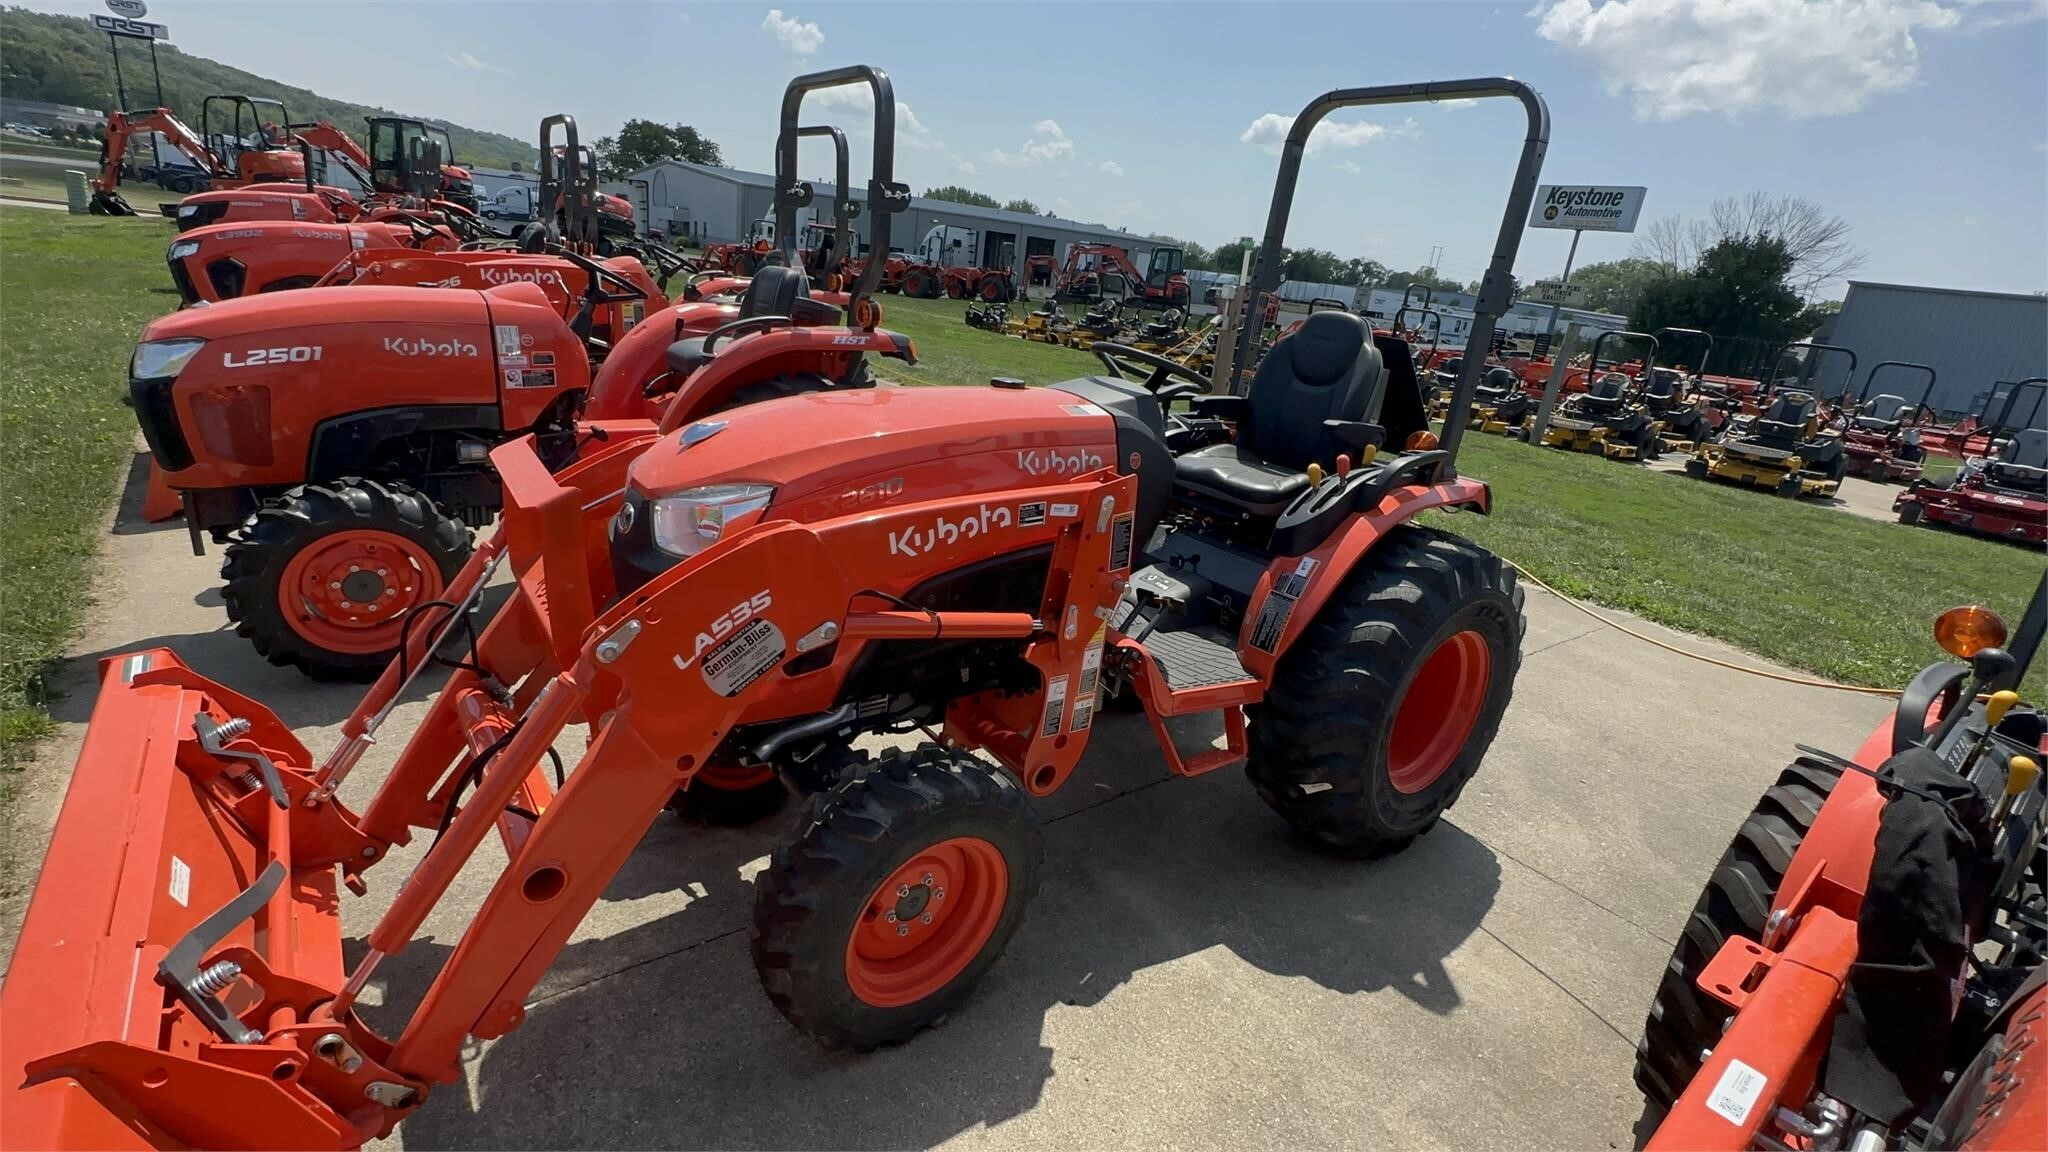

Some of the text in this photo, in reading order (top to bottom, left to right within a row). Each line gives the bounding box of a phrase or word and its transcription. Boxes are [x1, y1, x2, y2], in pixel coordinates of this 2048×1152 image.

[95, 16, 161, 35] CRST
[1546, 186, 1624, 208] Keystone
[1564, 206, 1622, 218] Automotive
[293, 228, 342, 241] Kubota
[480, 267, 556, 285] Kubota
[383, 337, 478, 357] Kubota
[832, 335, 870, 345] HST
[224, 346, 323, 368] L2501
[1018, 449, 1103, 476] Kubota
[889, 503, 1012, 558] Kubota
[673, 589, 772, 670] LA535
[704, 624, 772, 677] German-Bliss
[728, 643, 758, 669] EQUIPMENT
[734, 673, 760, 694] SERVICE
[762, 655, 782, 673] PARTS
